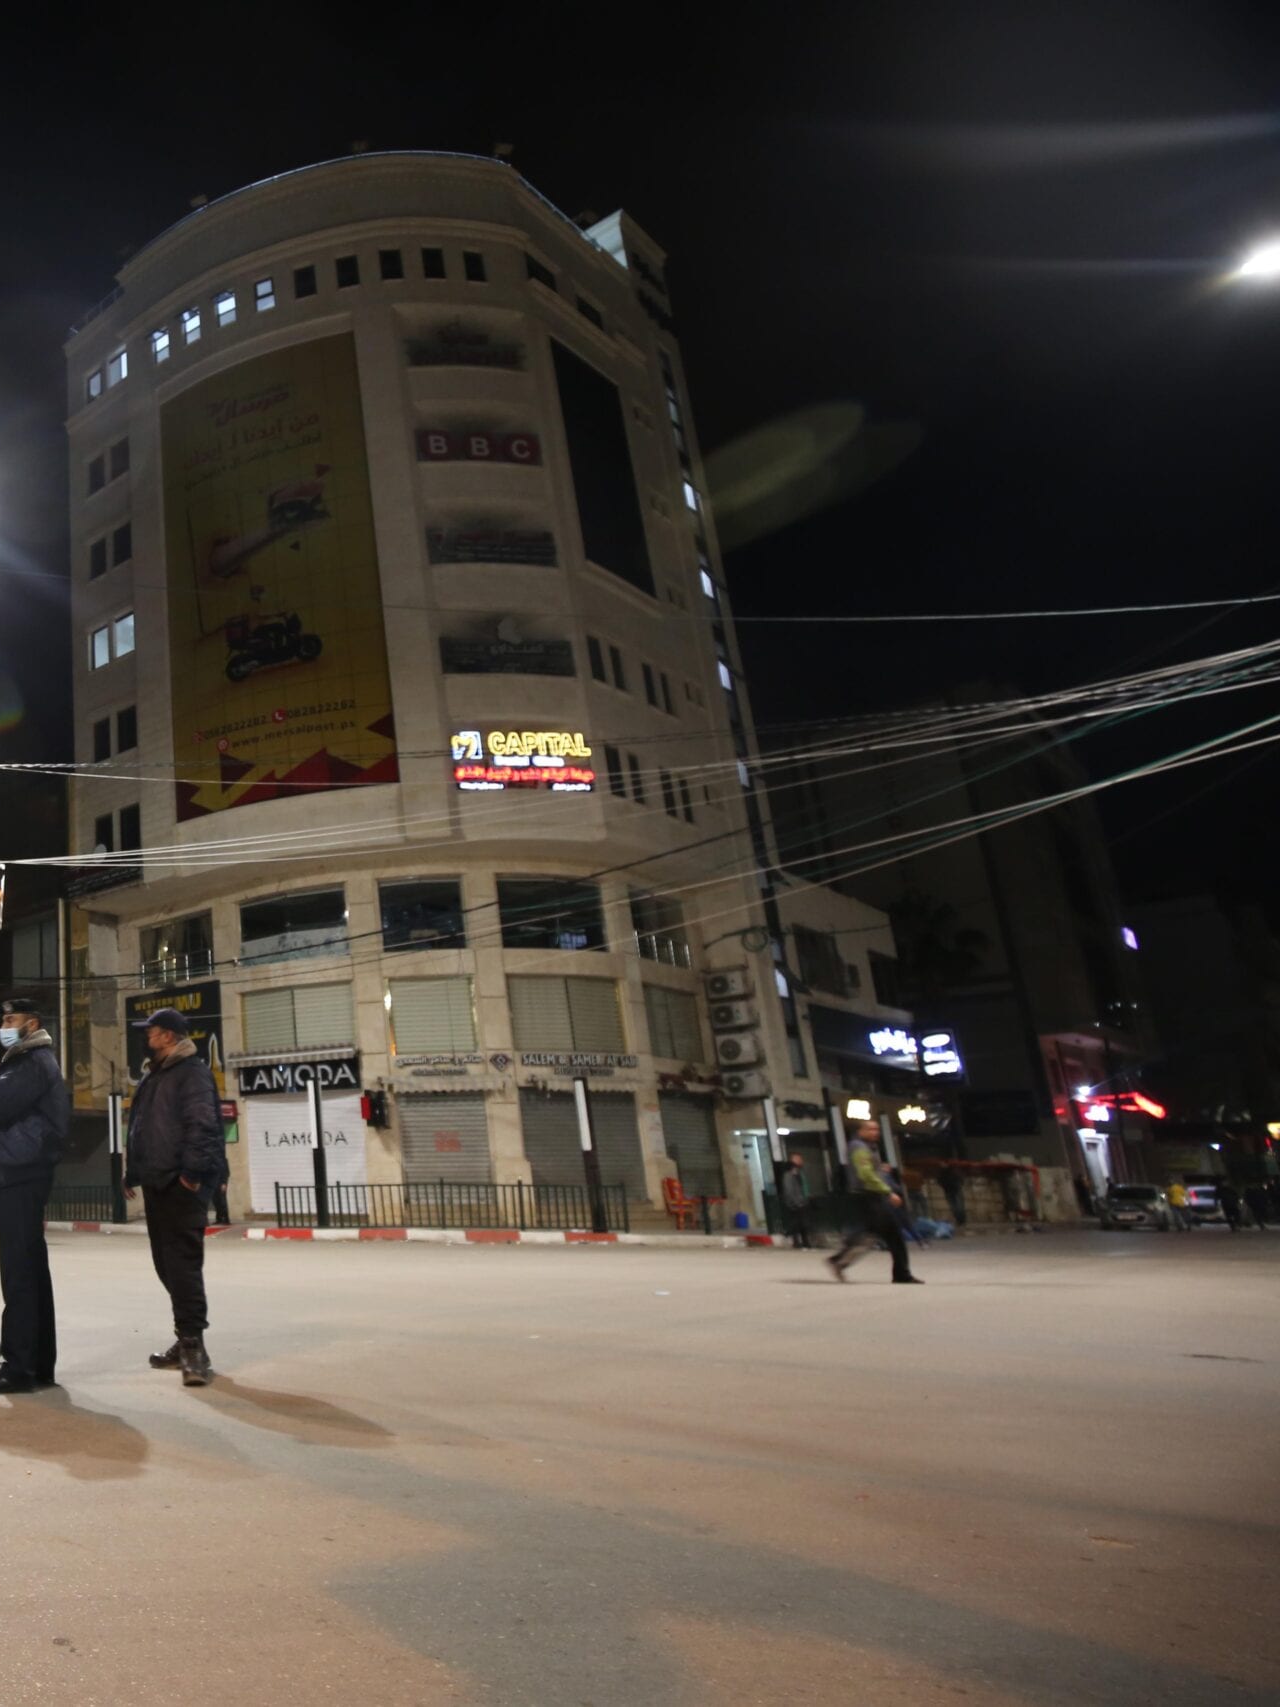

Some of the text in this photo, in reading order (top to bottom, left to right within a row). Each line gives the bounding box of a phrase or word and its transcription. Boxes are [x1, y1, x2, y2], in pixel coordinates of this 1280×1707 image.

[427, 434, 531, 459] BBC
[487, 731, 592, 757] CAPITAL
[522, 1053, 556, 1065] SALEM
[240, 1063, 356, 1091] LAMODA
